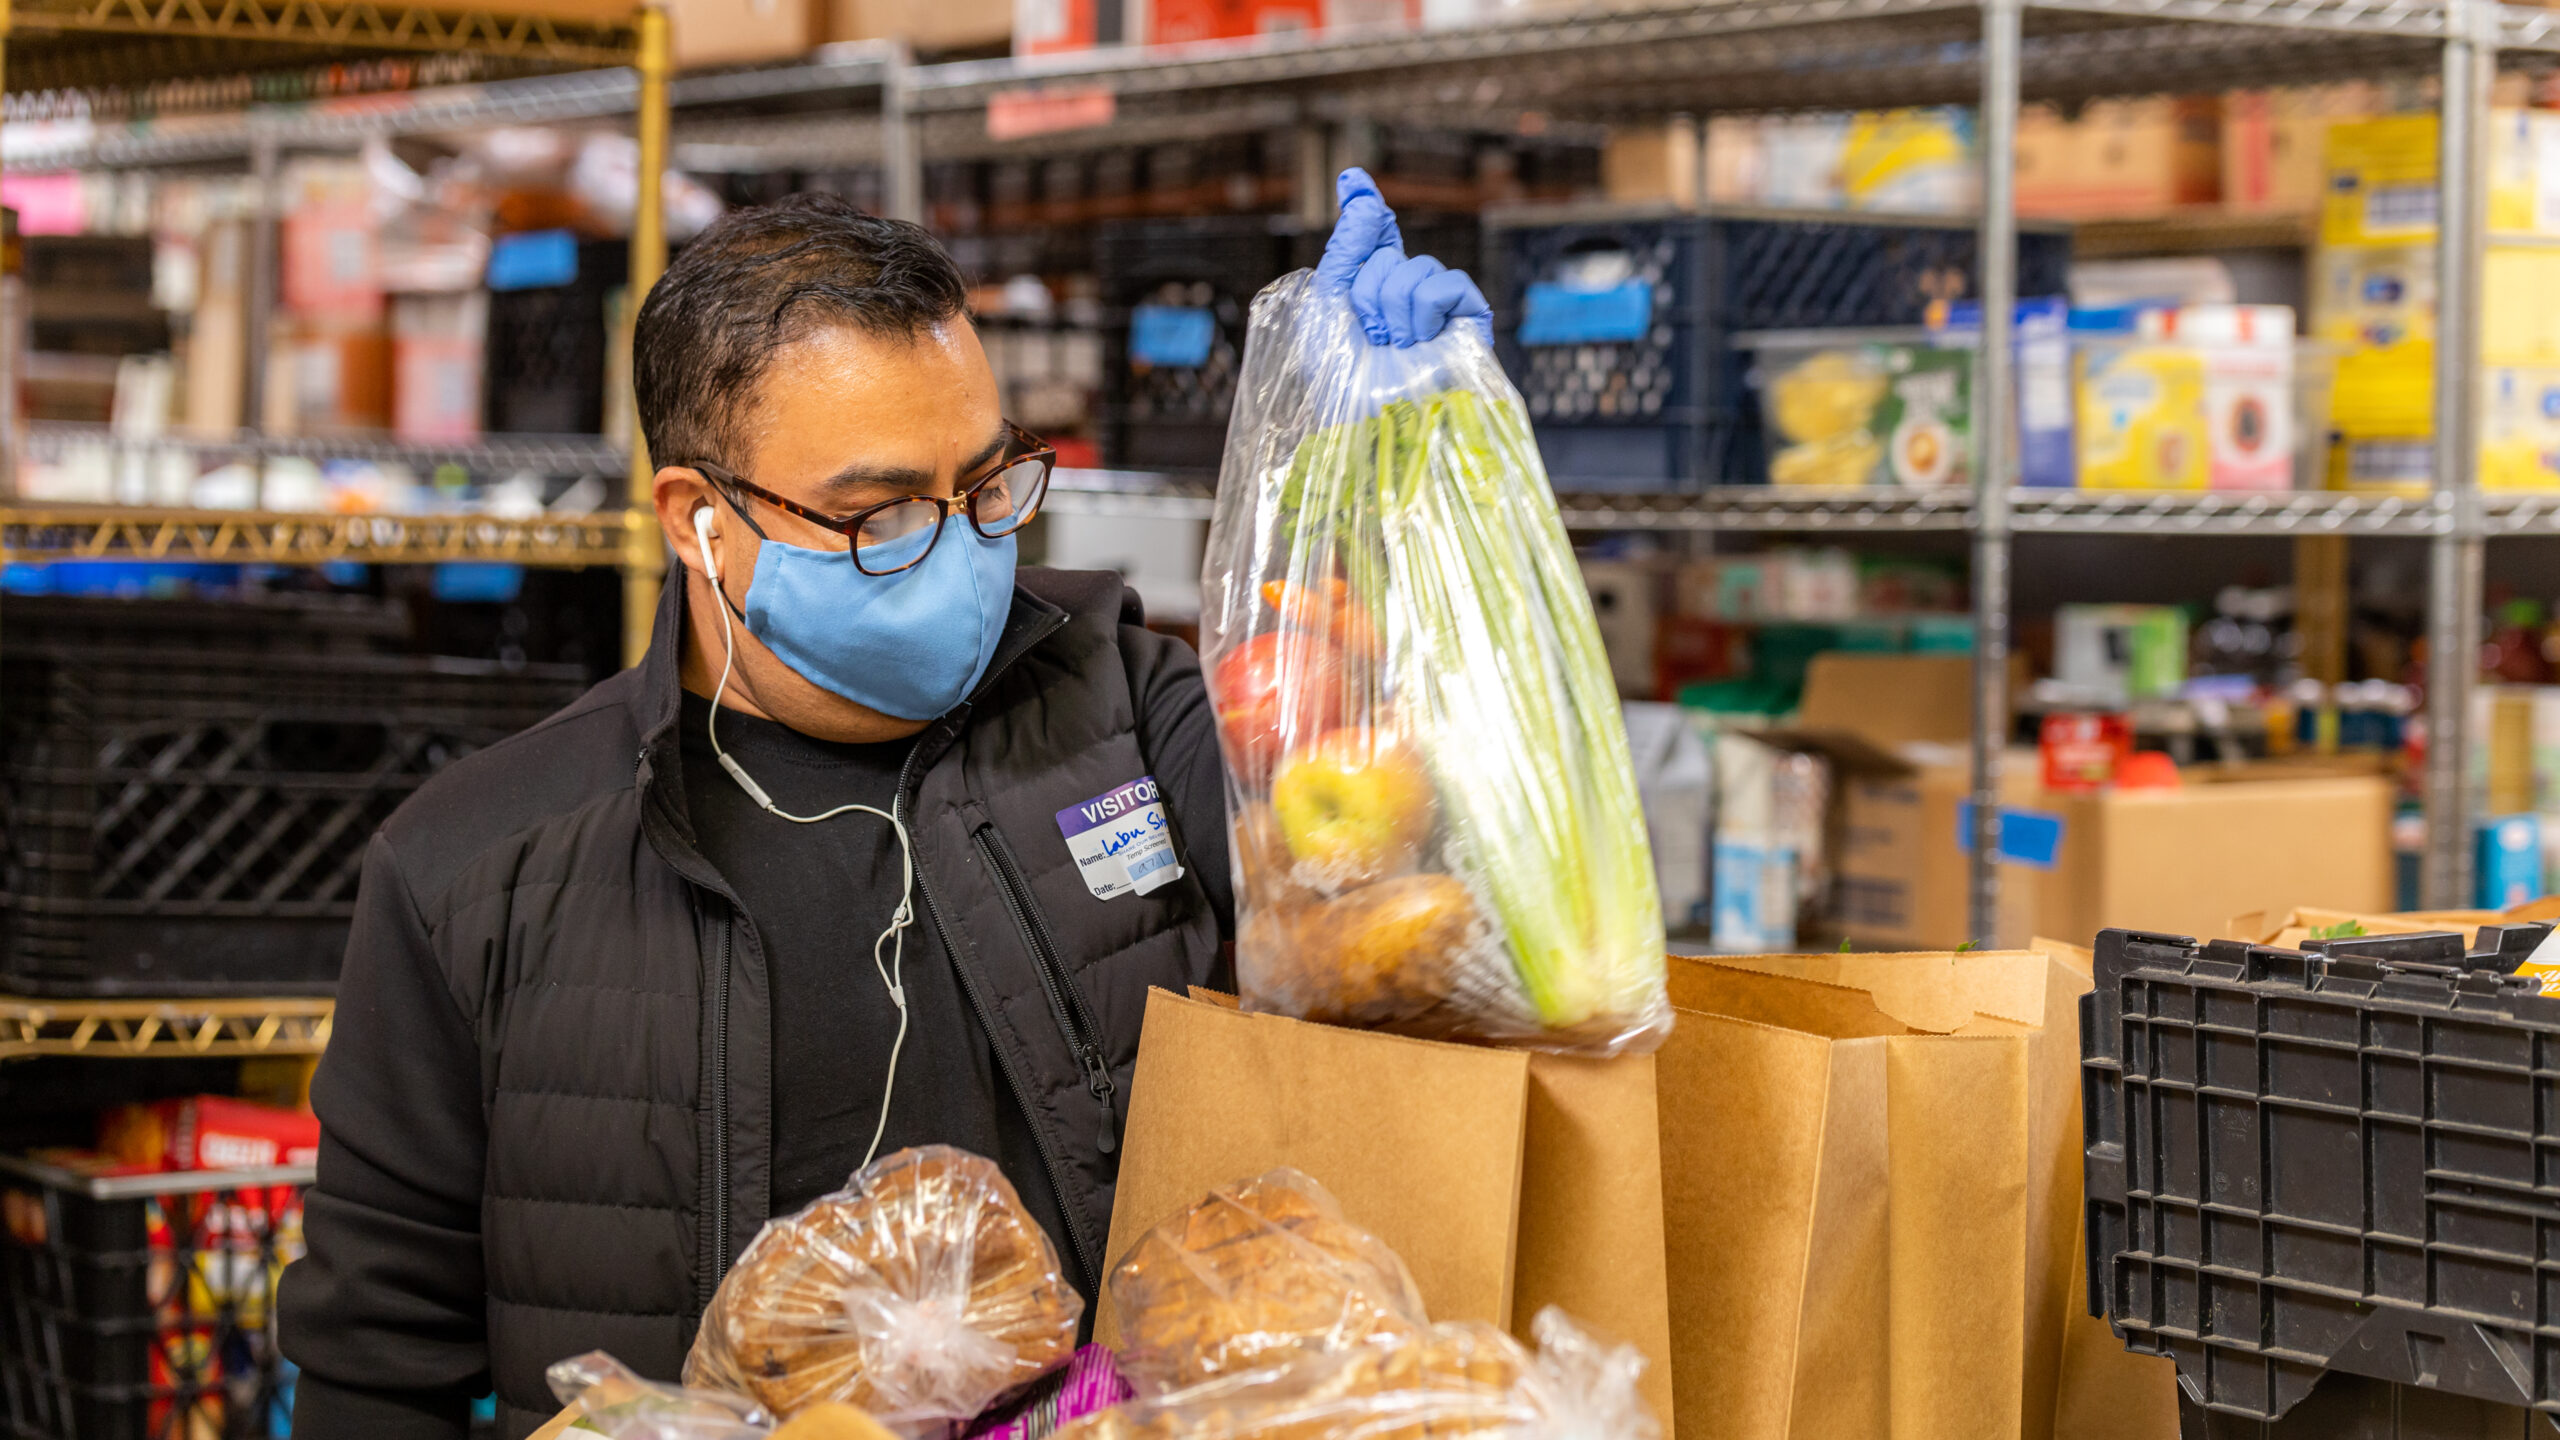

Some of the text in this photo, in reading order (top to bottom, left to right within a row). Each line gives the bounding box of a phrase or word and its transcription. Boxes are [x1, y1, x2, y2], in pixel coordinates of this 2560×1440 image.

[1081, 781, 1159, 823] VISITOR
[1127, 838, 1166, 860] Temp Screened
[1080, 852, 1105, 867] Name:
[1094, 883, 1116, 896] Date:
